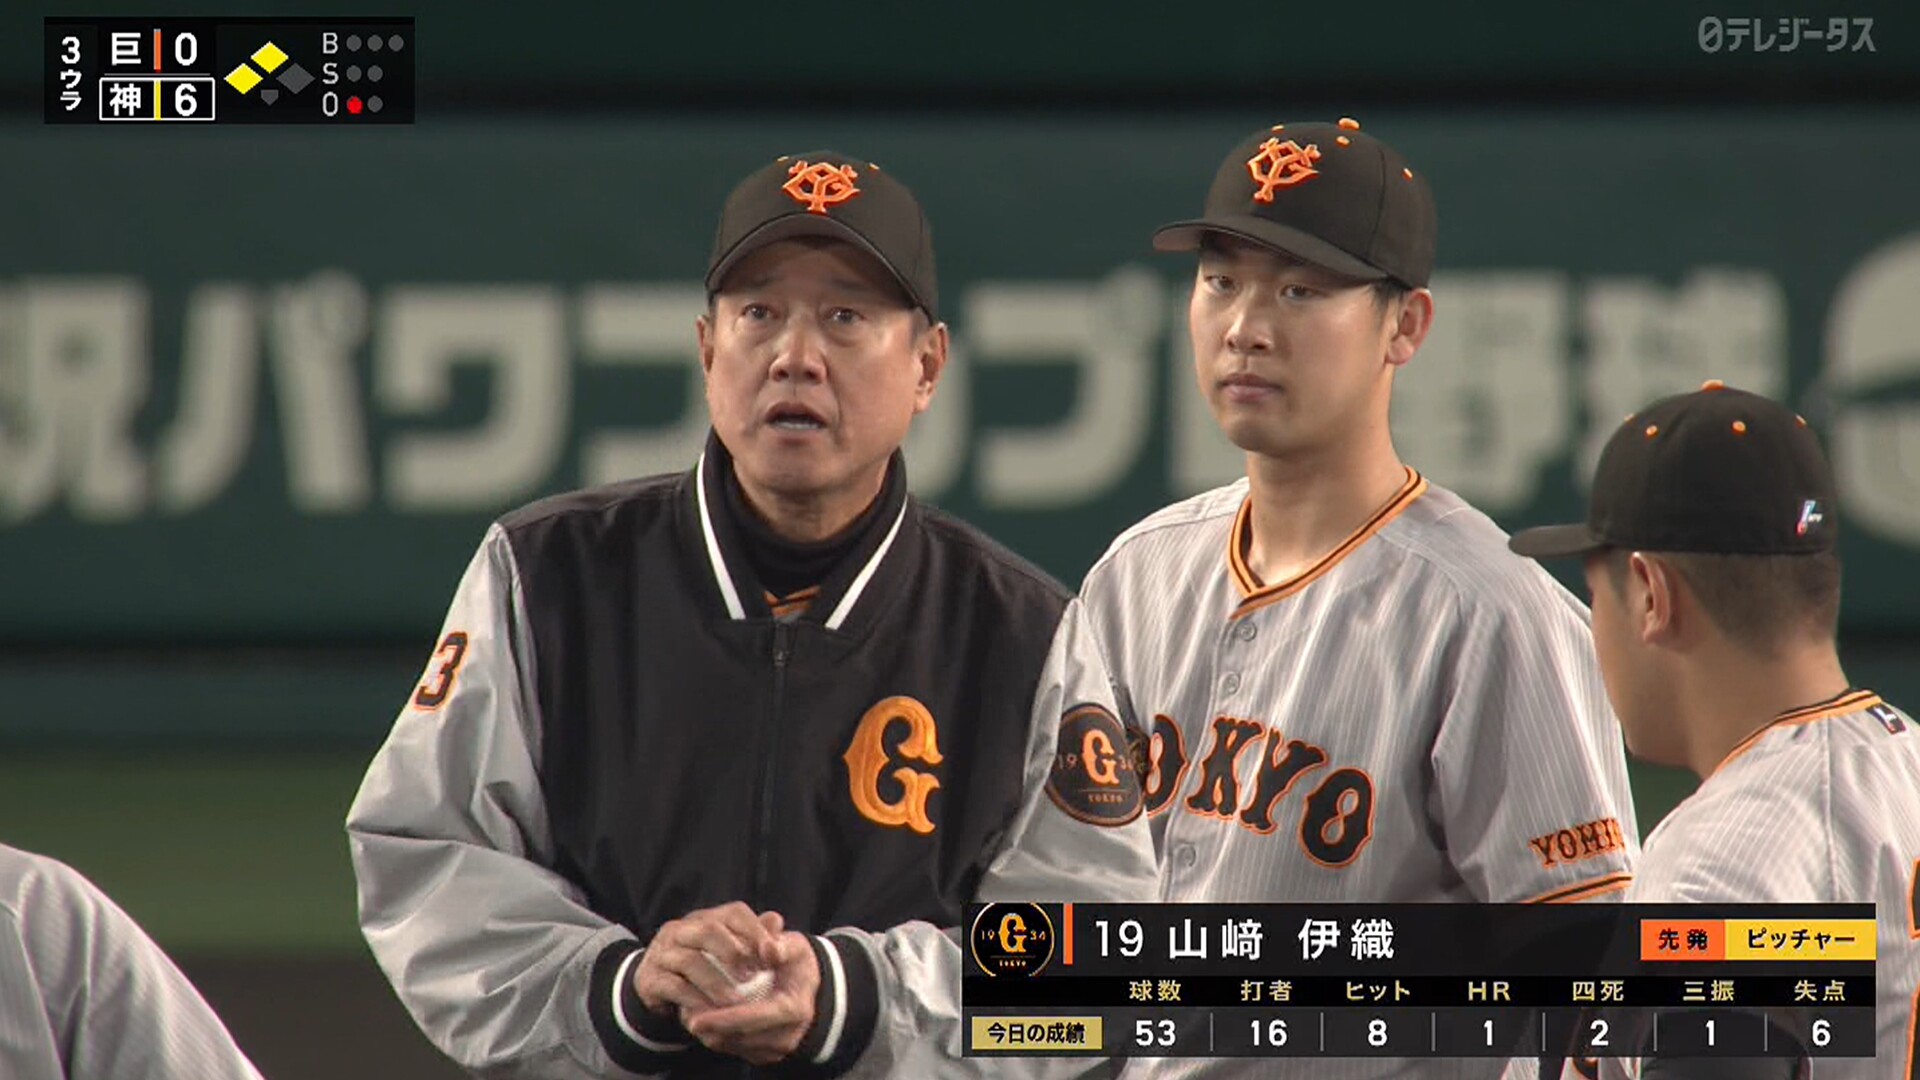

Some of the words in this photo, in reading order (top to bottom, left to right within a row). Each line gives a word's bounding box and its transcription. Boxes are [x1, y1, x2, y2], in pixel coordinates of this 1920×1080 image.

[843, 695, 943, 833] G
[1082, 728, 1120, 786] G
[1145, 713, 1376, 869] OKYO
